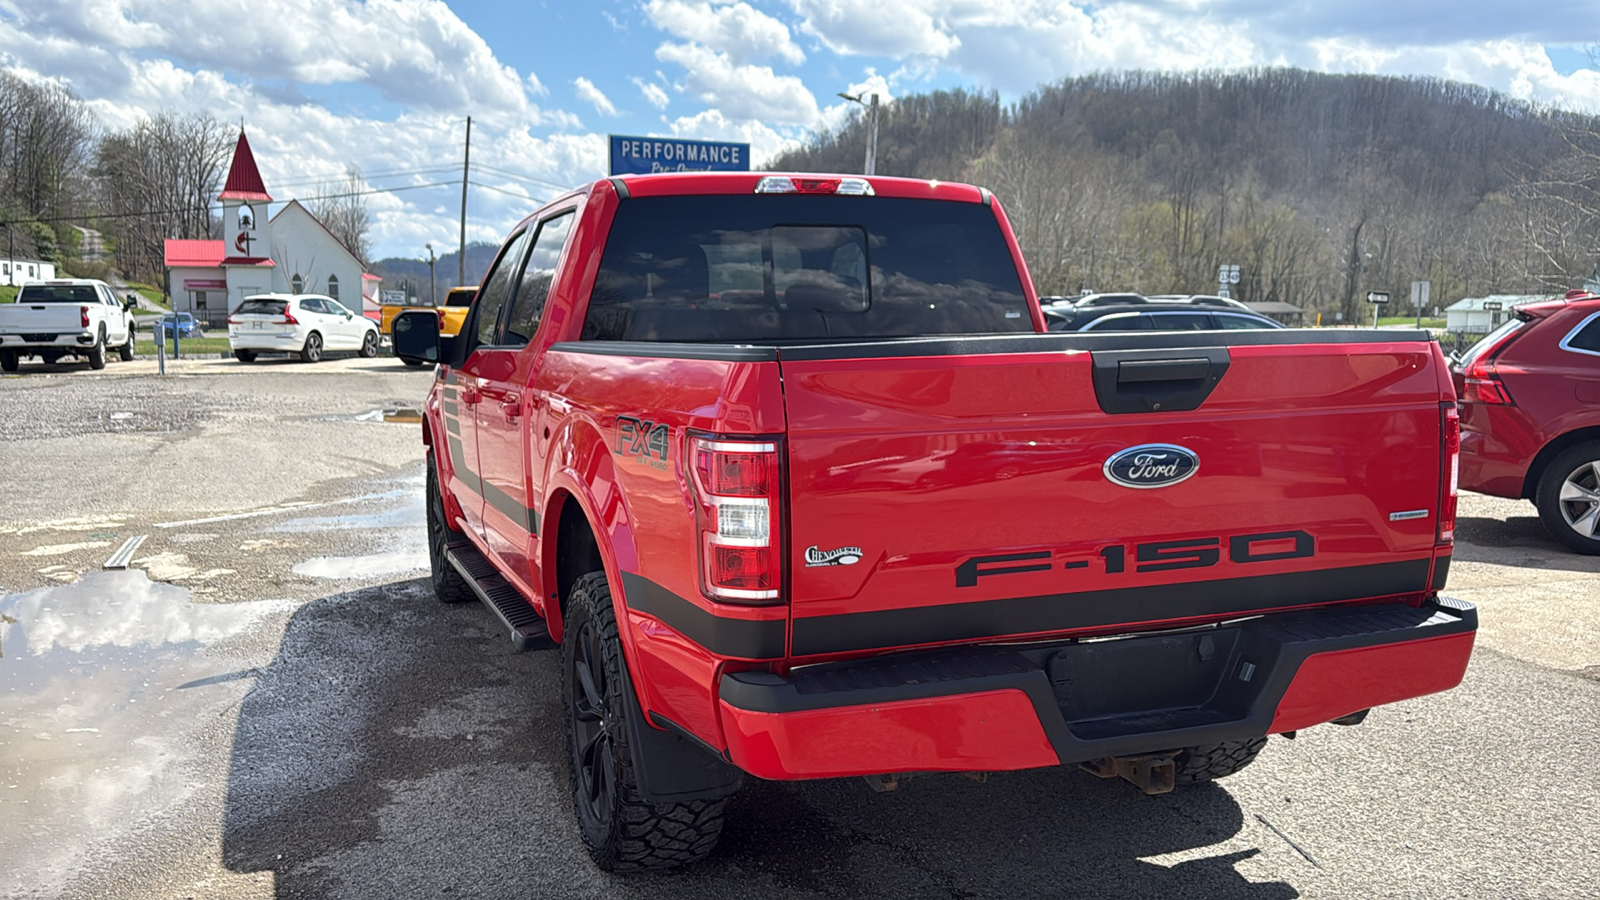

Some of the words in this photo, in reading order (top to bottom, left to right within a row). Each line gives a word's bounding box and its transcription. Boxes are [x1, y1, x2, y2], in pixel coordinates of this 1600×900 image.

[622, 140, 740, 163] PERFORMANCE
[614, 415, 668, 462] FX4
[1128, 453, 1180, 479] Ford
[956, 530, 1315, 587] F-150
